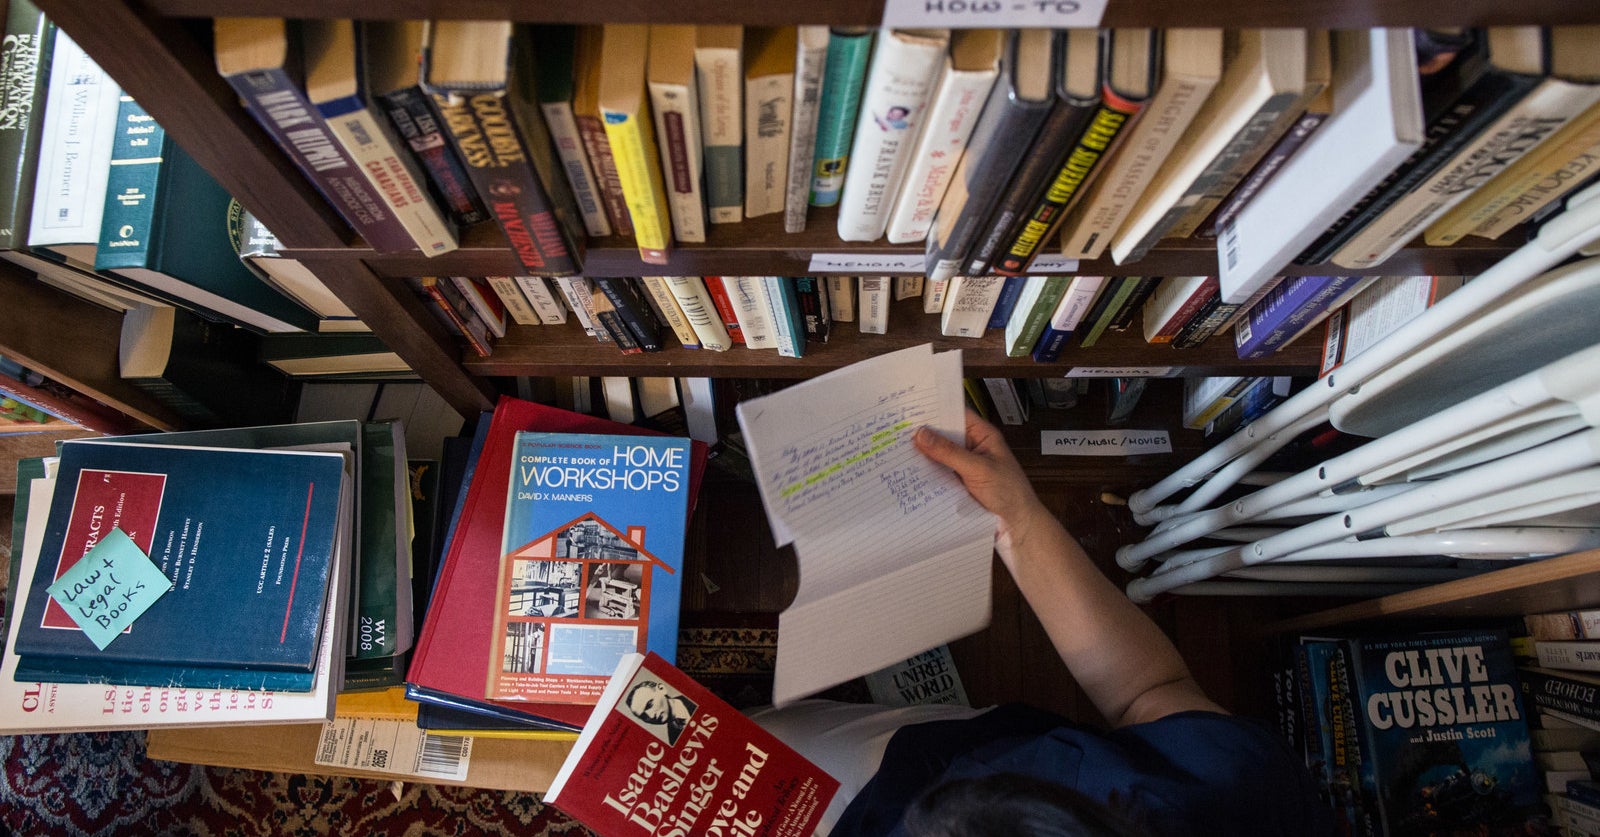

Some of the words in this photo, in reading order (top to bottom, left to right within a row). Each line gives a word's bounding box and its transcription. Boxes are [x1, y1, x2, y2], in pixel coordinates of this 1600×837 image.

[3, 32, 30, 130] RATIFICATION
[17, 46, 40, 114] FRAMING
[67, 88, 87, 136] William
[1152, 78, 1196, 137] FLIGHT
[59, 151, 78, 197] Bennett
[872, 140, 898, 183] FRANK
[1116, 149, 1152, 204] PASSAGE
[364, 160, 409, 209] CANADIANS
[863, 184, 886, 217] BRUNI
[679, 295, 713, 327] FAMILY
[520, 455, 568, 465] COMPLETE
[571, 457, 597, 466] BOOK
[599, 458, 611, 466] OF
[613, 446, 684, 468] HOME
[518, 492, 542, 501] DAVID
[543, 493, 549, 501] X
[552, 494, 593, 502] MANNERS
[520, 466, 680, 493] WORKSHOPS
[114, 493, 126, 518] Edition
[83, 505, 105, 557] TRACTS
[166, 530, 175, 553] DAWSON
[175, 540, 186, 567] BURNETT
[181, 517, 191, 541] HARVEY
[267, 525, 276, 546] (SALES)
[183, 565, 194, 590] STANLEY
[192, 521, 204, 557] HENDERSON
[259, 552, 271, 579] ARTICLE
[275, 551, 286, 585] FOUNDATION
[63, 570, 101, 602] Law
[79, 574, 122, 618] Legal
[95, 580, 145, 630] Books
[256, 578, 265, 594] UCC
[360, 617, 373, 651] 2008
[893, 660, 948, 689] UNFREE
[1385, 645, 1489, 688] CLIVE
[900, 674, 954, 705] WORLD
[1367, 683, 1521, 731] CUSSLER
[1544, 679, 1596, 704] ECHOED
[1332, 704, 1346, 768] CUSSLER
[1410, 736, 1423, 744] and
[1426, 728, 1464, 743] Justin
[1466, 726, 1496, 740] Scott
[601, 741, 665, 819] Isaac
[629, 713, 720, 837] Bashevis
[732, 742, 769, 798] and
[657, 757, 726, 837] Singer
